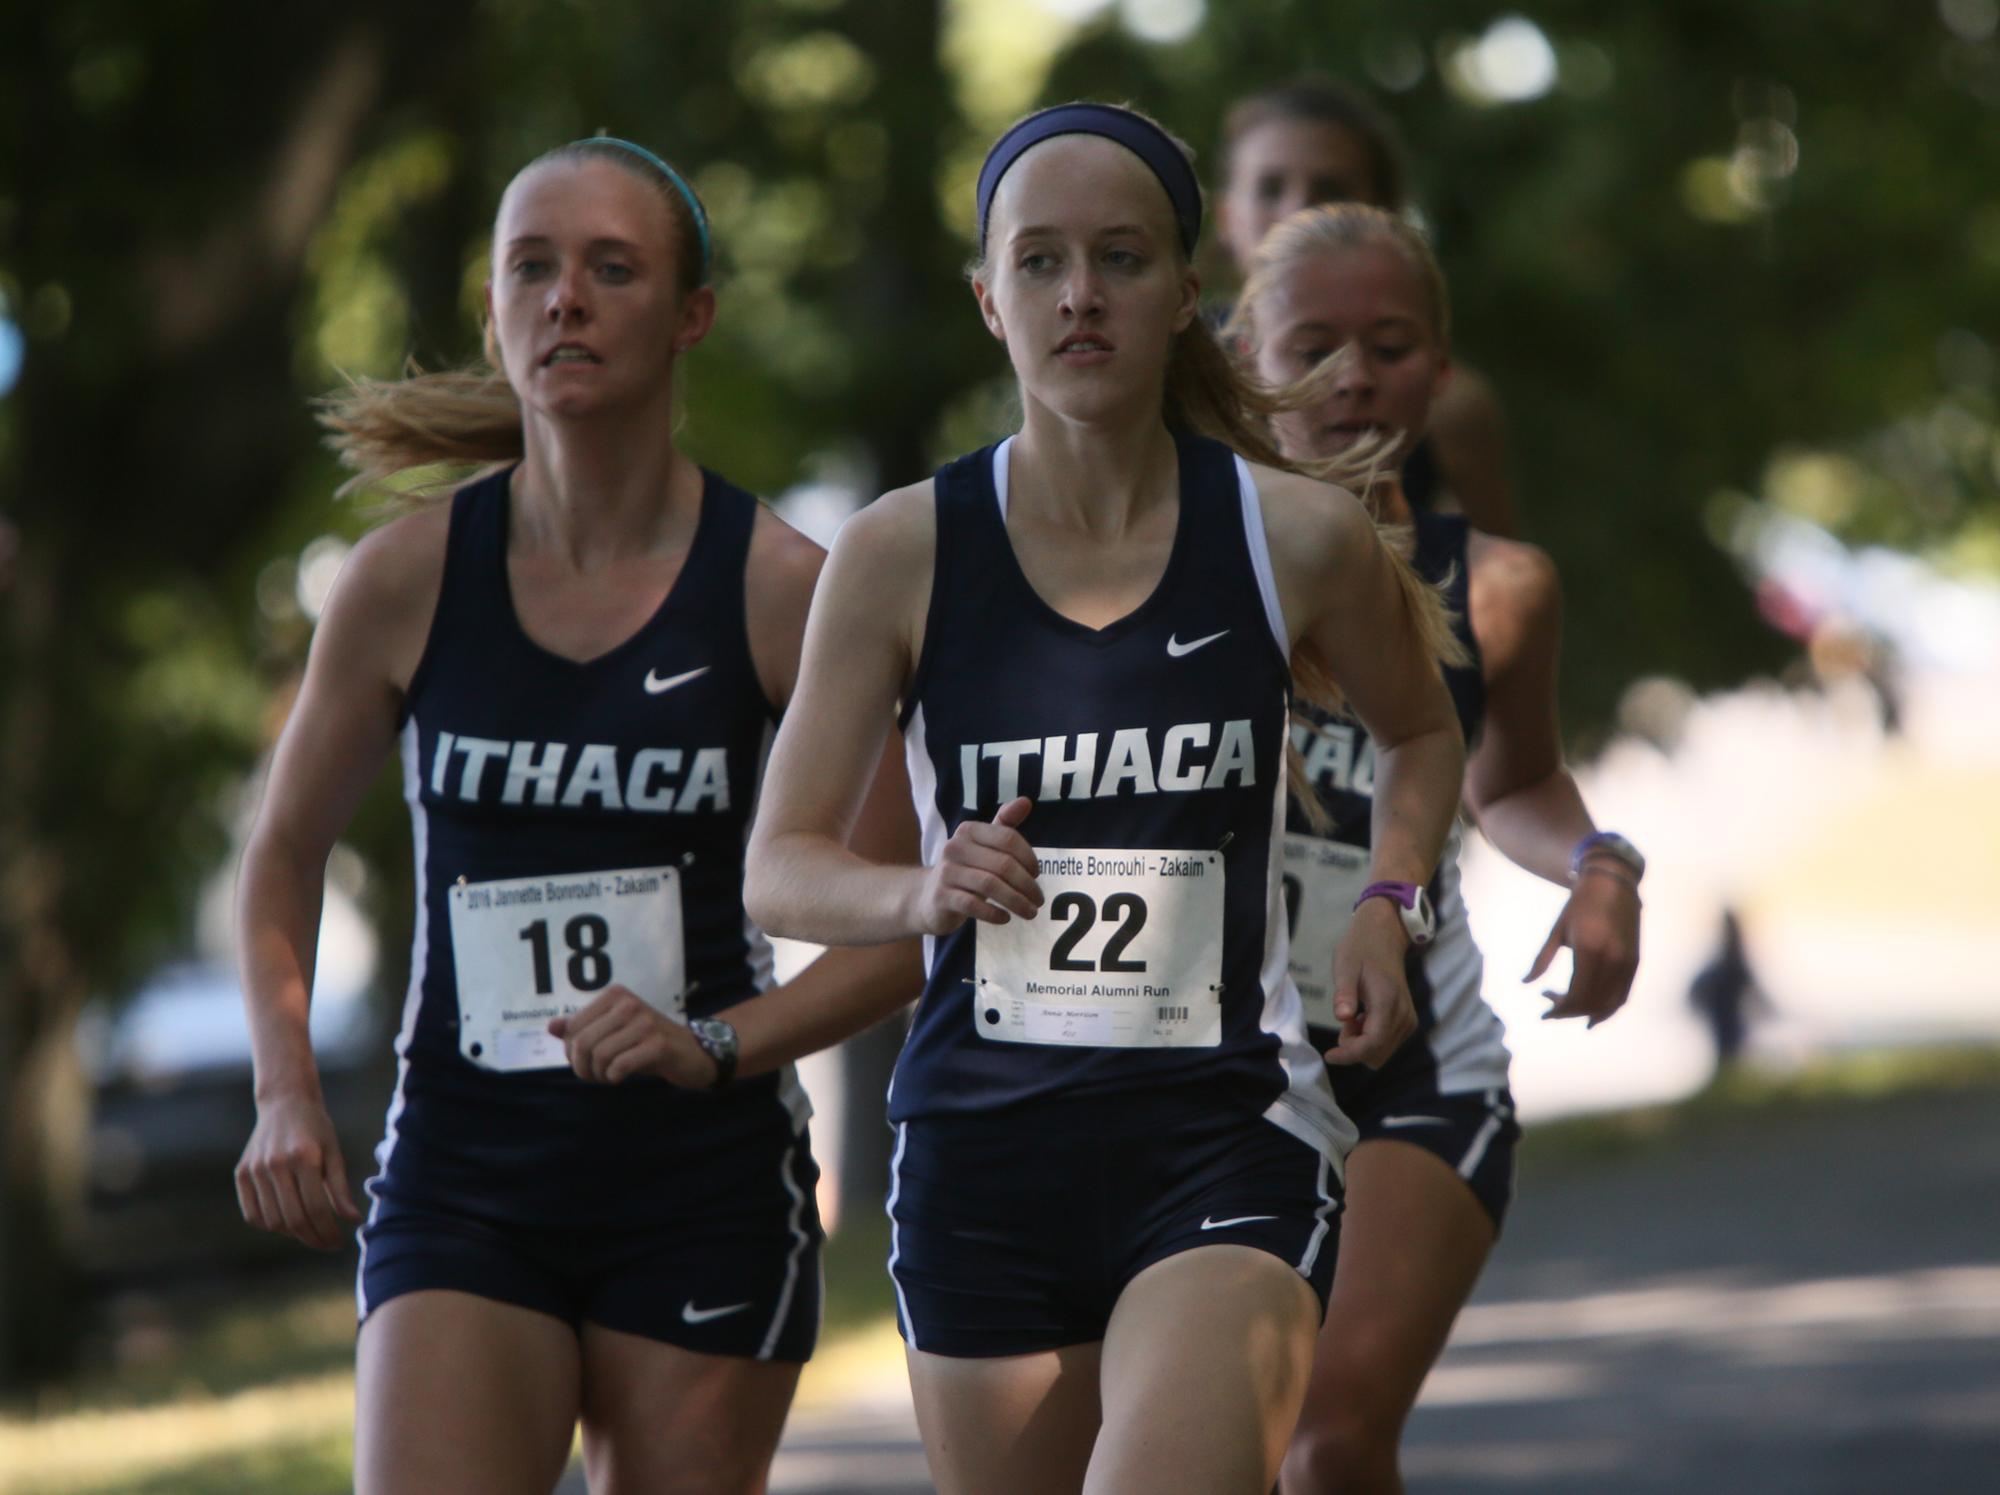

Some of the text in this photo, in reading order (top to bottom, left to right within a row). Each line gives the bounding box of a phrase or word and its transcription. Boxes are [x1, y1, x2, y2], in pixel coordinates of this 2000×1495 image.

[431, 731, 731, 812] ITHACA
[961, 719, 1256, 810] ITHACA
[615, 875, 660, 896] Zakaim
[1038, 857, 1083, 876] annette
[1087, 856, 1145, 876] Bonrouhi
[1159, 856, 1204, 877] Zakaim
[519, 913, 613, 995] 18
[1049, 891, 1148, 973] 22
[1026, 981, 1170, 997] Memorial Alumni Run
